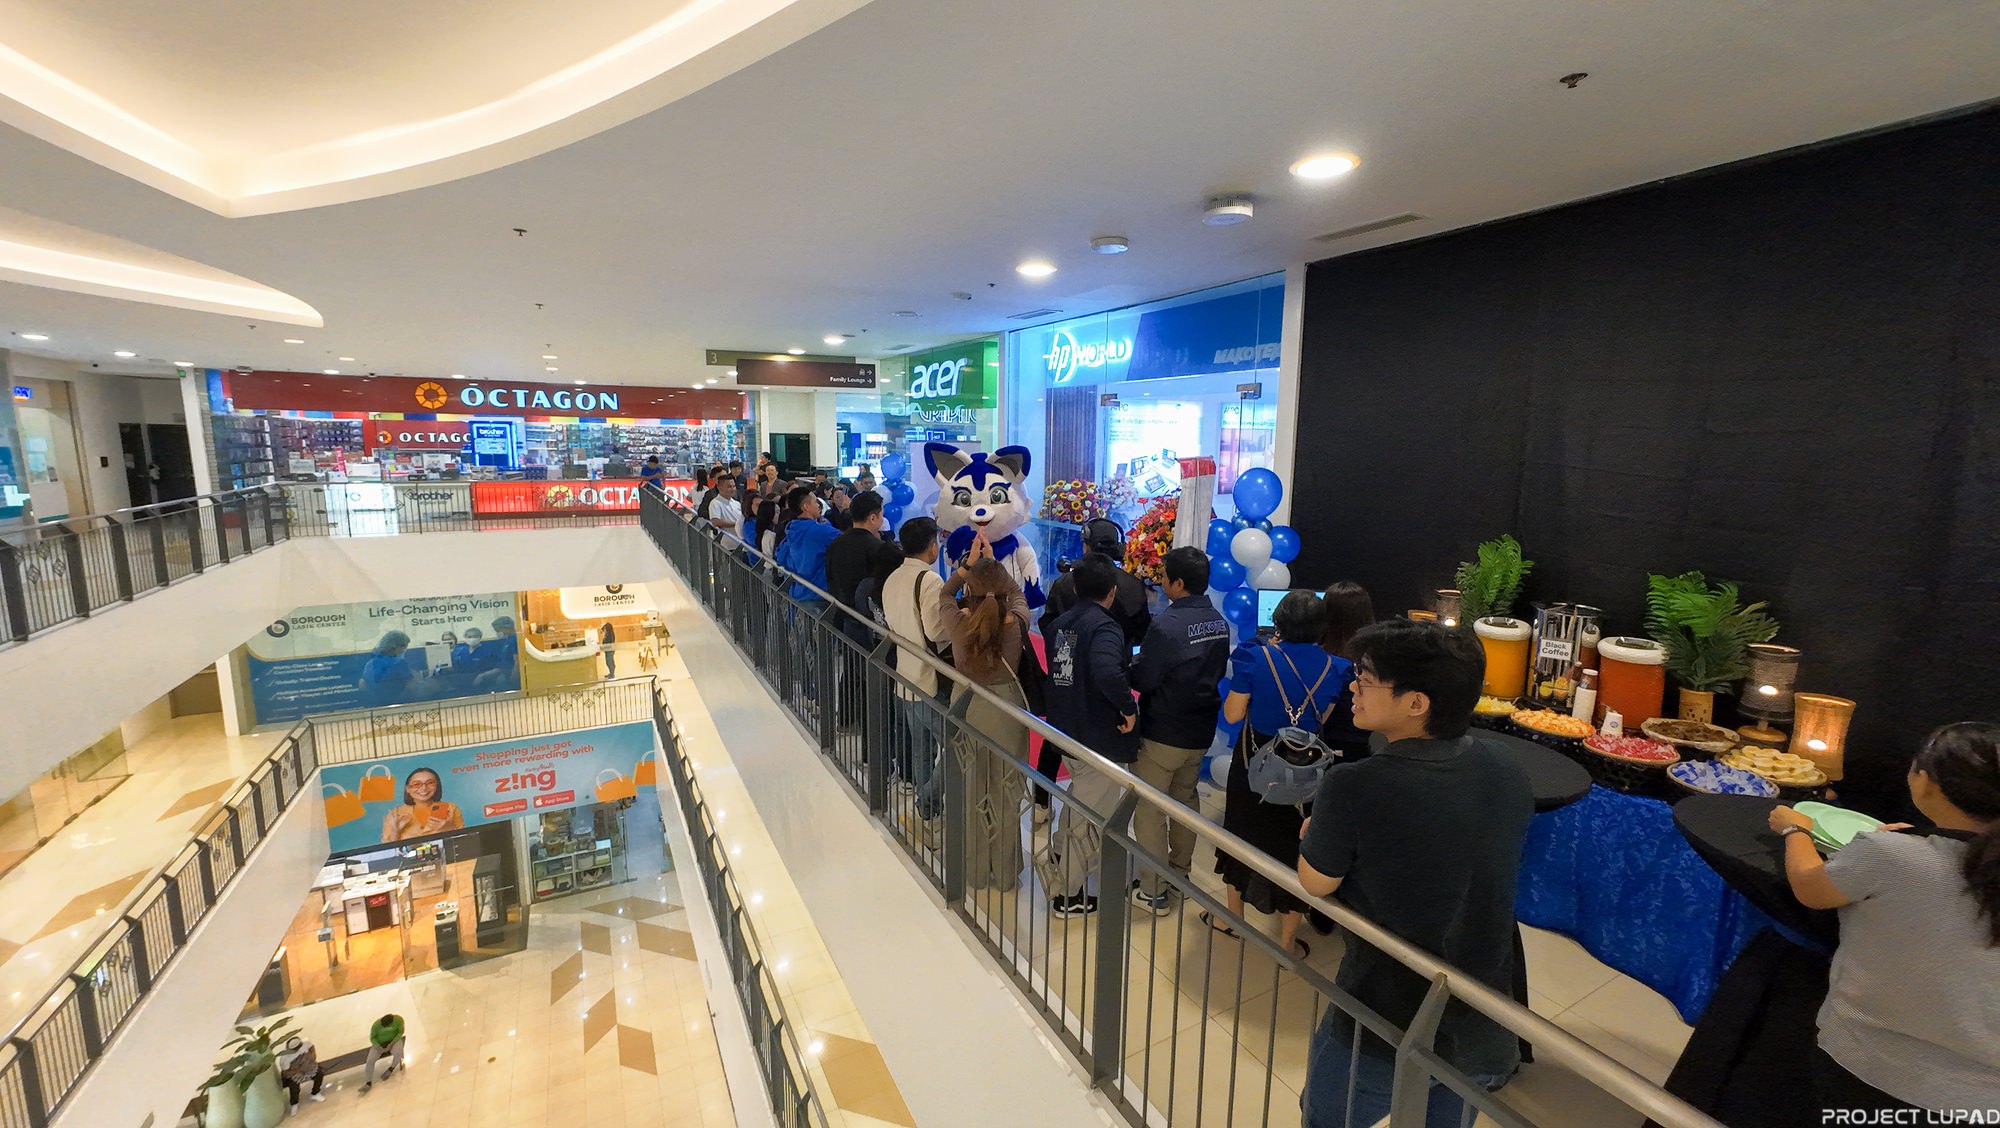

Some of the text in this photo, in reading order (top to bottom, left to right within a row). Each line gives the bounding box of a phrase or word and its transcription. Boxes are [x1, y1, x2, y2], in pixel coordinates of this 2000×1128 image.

[711, 352, 718, 364] 3
[1043, 332, 1130, 382] hp WORLD
[911, 358, 967, 399] acer
[460, 387, 619, 411] OCTAGON
[399, 432, 471, 443] OCTAGO
[580, 486, 694, 505] OCTAON
[594, 594, 635, 603] BOROUGH
[369, 600, 509, 618] Life-Changing Vision
[291, 615, 346, 625] BOROUGH
[411, 615, 473, 626] Starts Here
[1188, 620, 1227, 637] MAKOTE
[1541, 648, 1569, 657] Coffee
[1545, 641, 1567, 650] Black
[451, 744, 594, 774] even more rewarding with
[476, 740, 572, 761] Shopping just got
